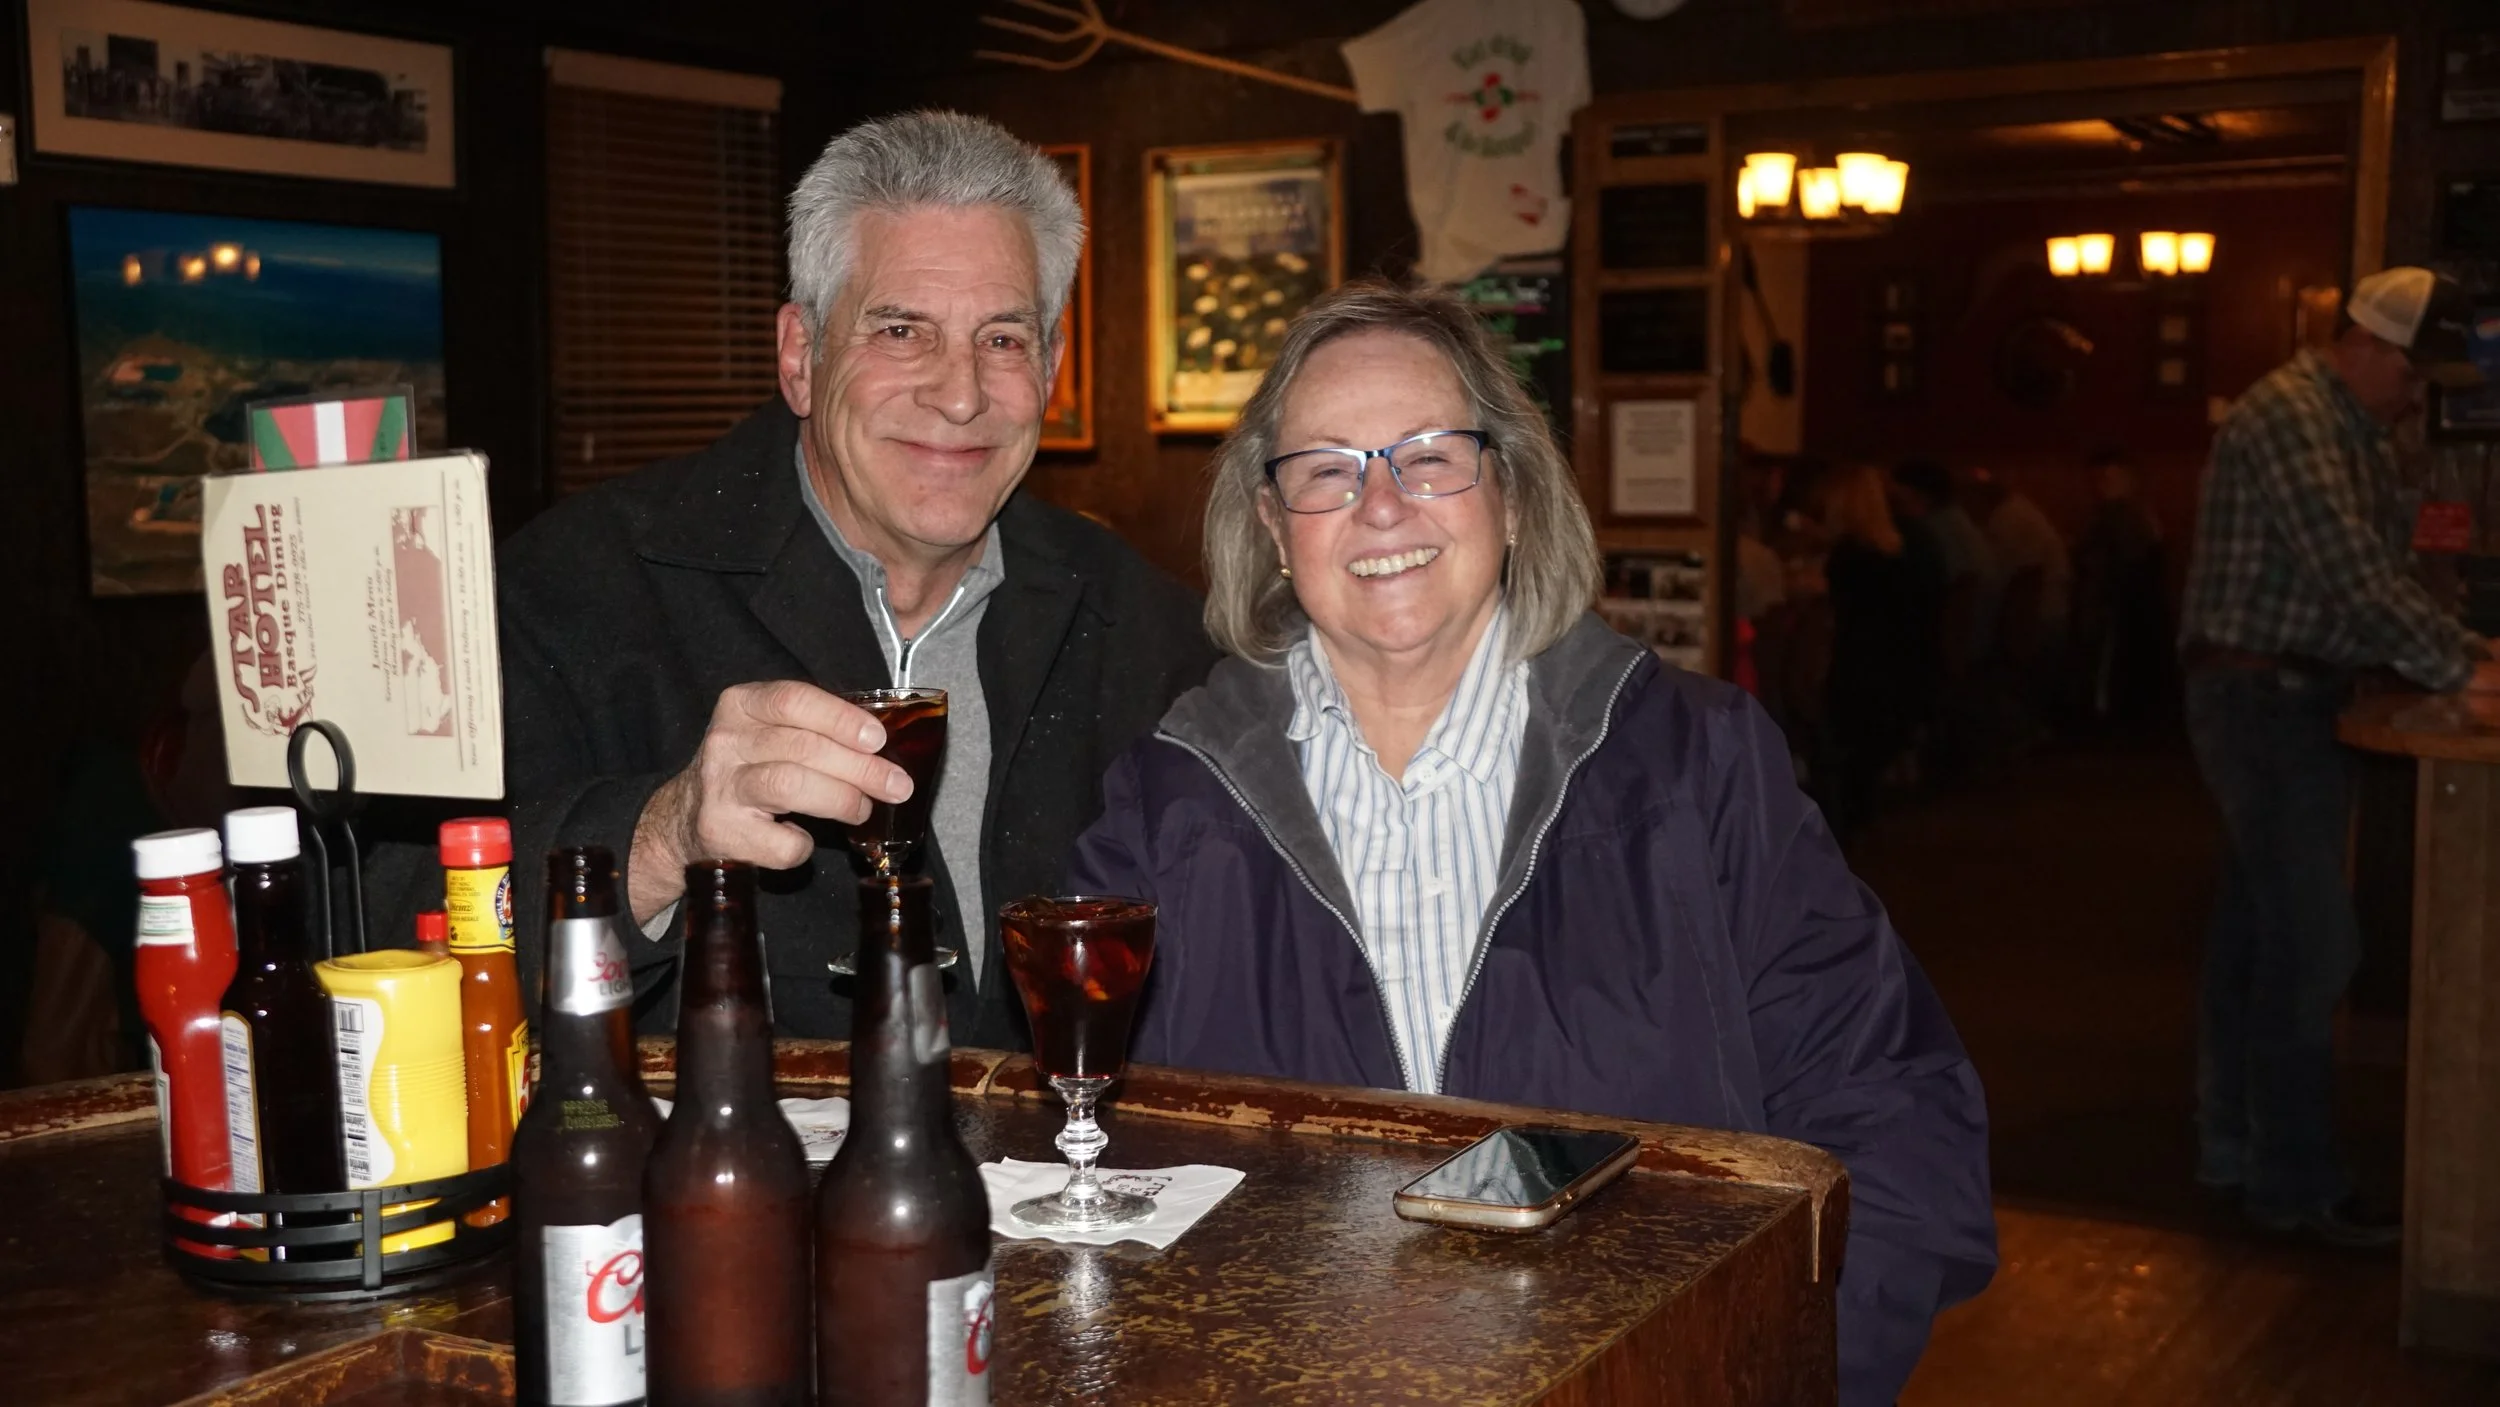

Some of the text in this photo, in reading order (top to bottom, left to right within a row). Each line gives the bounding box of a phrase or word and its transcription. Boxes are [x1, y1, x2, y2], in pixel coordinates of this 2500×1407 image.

[223, 563, 261, 713] STAR
[243, 504, 285, 689] HOTEL
[270, 503, 298, 688] Basque Dining
[367, 576, 381, 671] Lunch Menu
[497, 900, 507, 925] GRILL
